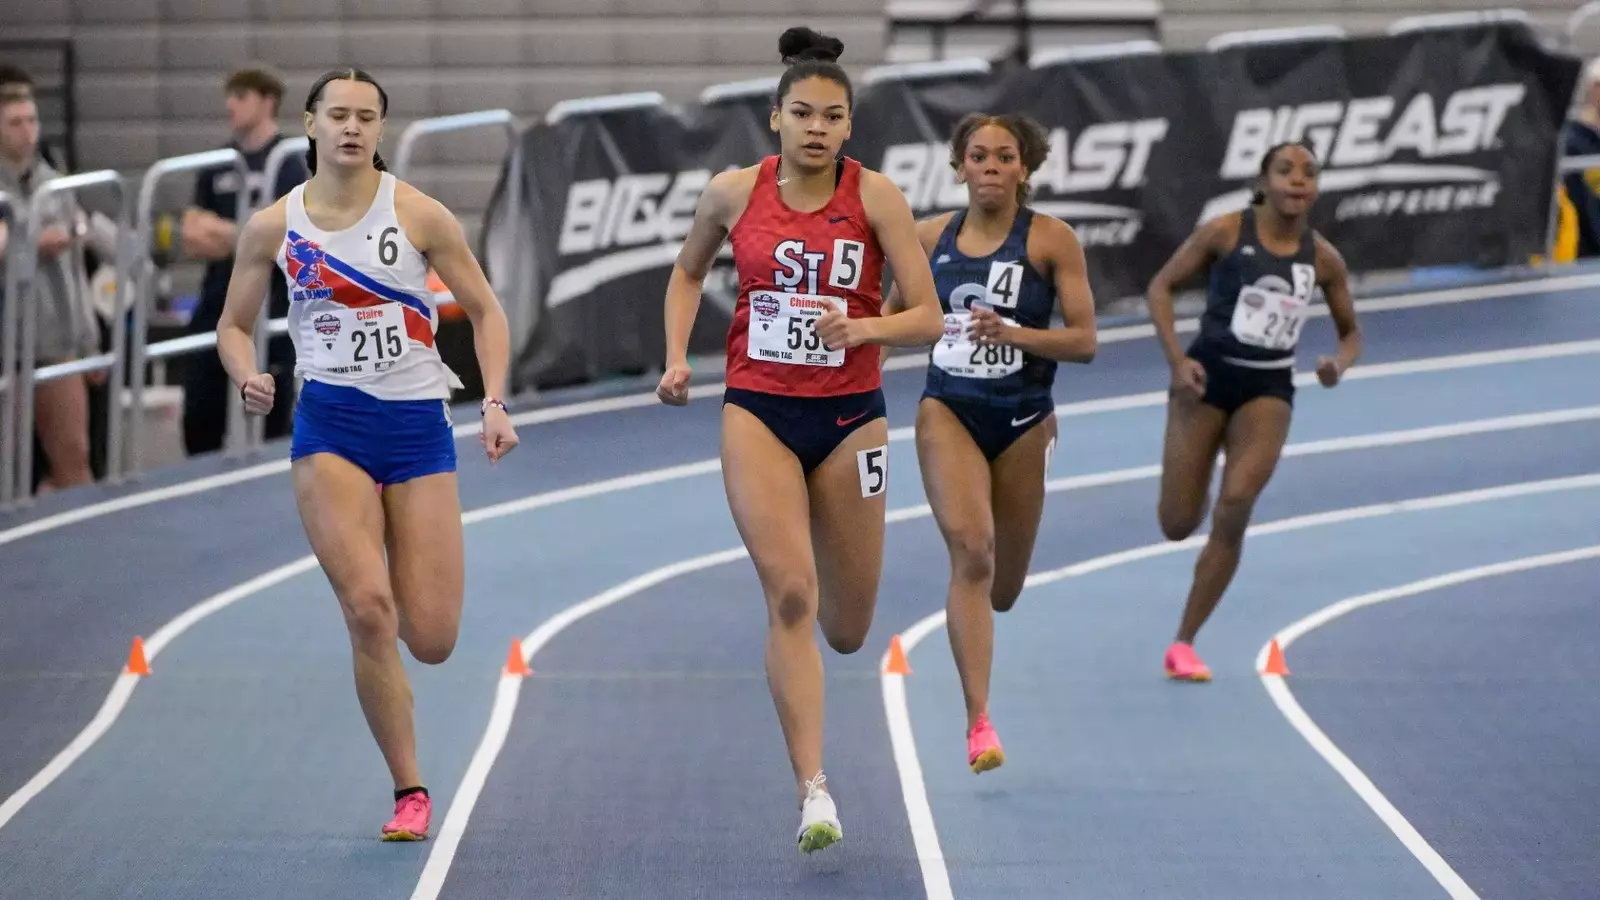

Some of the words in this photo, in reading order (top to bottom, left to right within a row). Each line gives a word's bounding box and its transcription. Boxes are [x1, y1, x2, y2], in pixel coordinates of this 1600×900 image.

[379, 226, 399, 267] 6
[837, 242, 859, 286] 5
[992, 267, 1014, 304] 4
[1299, 268, 1312, 300] 3
[356, 309, 383, 321] Claire
[351, 325, 402, 362] 215
[787, 316, 836, 352] 53
[349, 364, 363, 373] TAG
[759, 348, 780, 358] TIMING
[780, 350, 793, 360] TAG
[969, 342, 1016, 366] 280
[866, 449, 883, 494] 5
